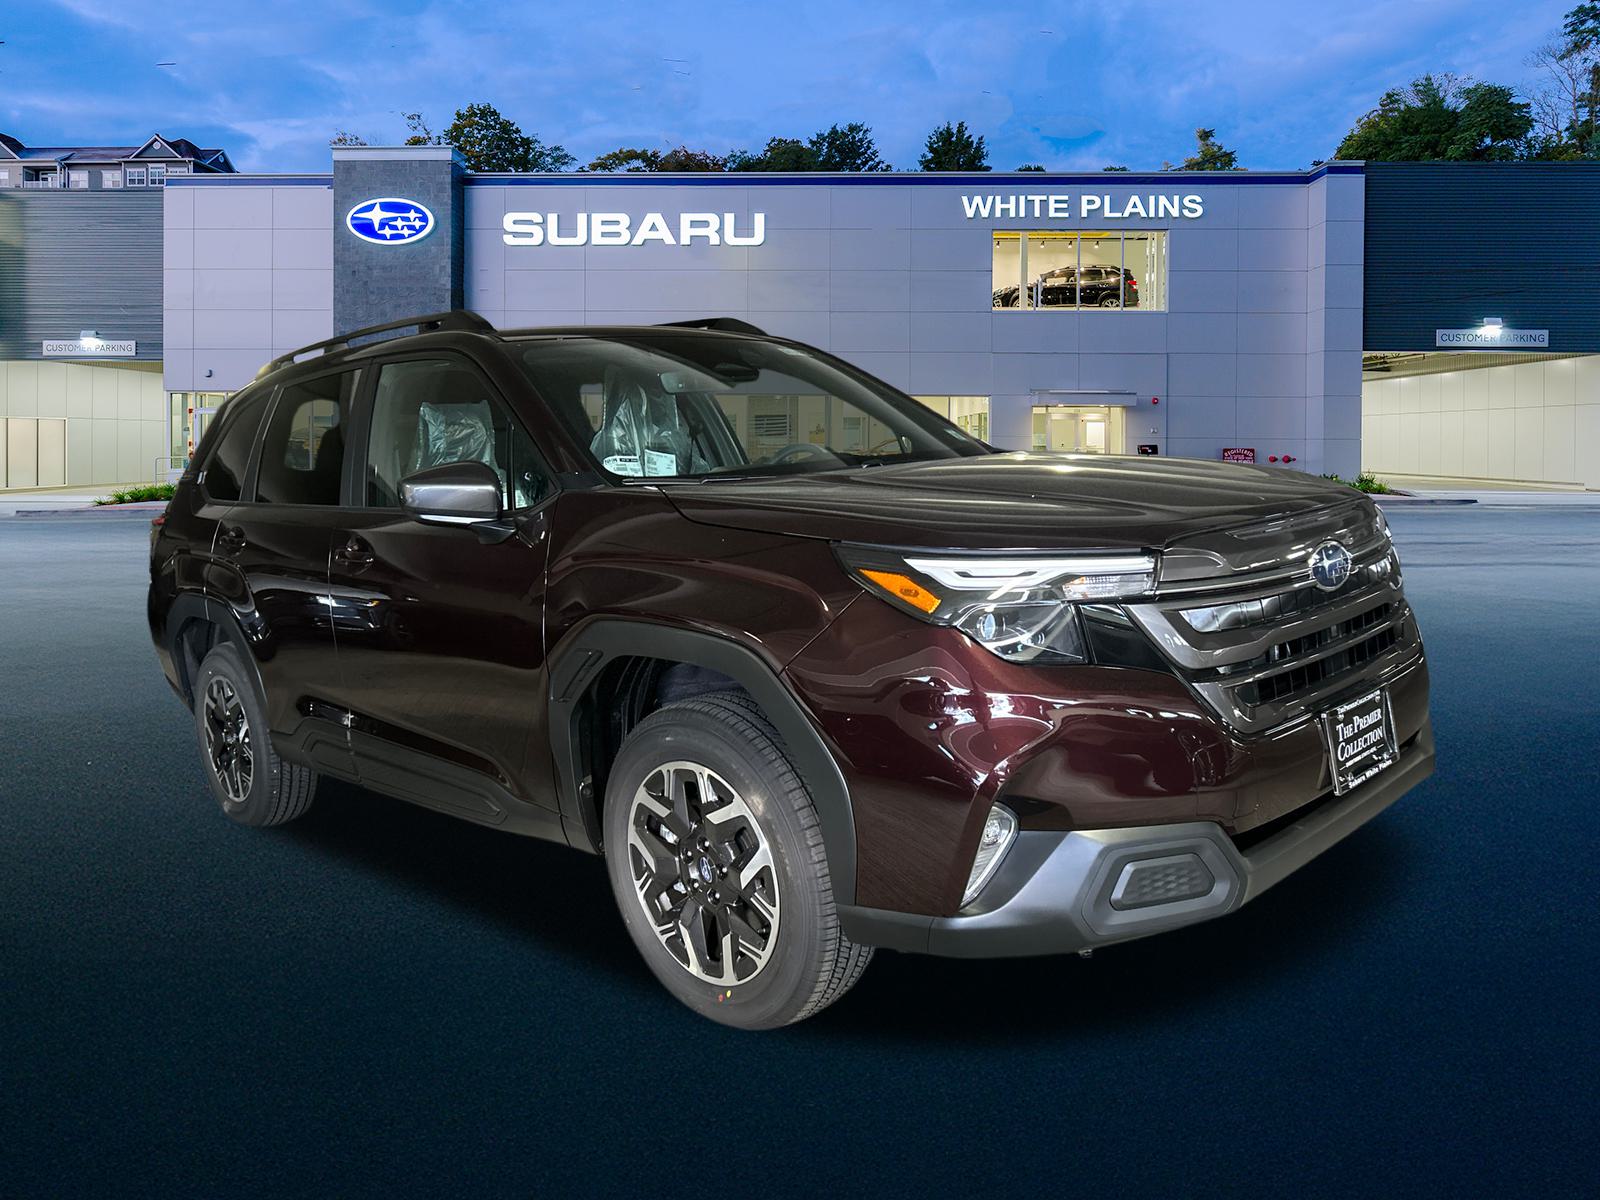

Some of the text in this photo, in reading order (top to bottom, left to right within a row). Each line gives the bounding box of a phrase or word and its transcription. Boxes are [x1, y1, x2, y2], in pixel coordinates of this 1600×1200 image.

[961, 194, 1205, 219] WHITE PLAINS
[502, 211, 766, 247] SUBARU
[94, 343, 133, 352] PARKING
[1440, 332, 1545, 343] CUSTOMER PARKING
[1336, 708, 1382, 742] THE PREMIER
[1337, 726, 1383, 761] COLLECTION
